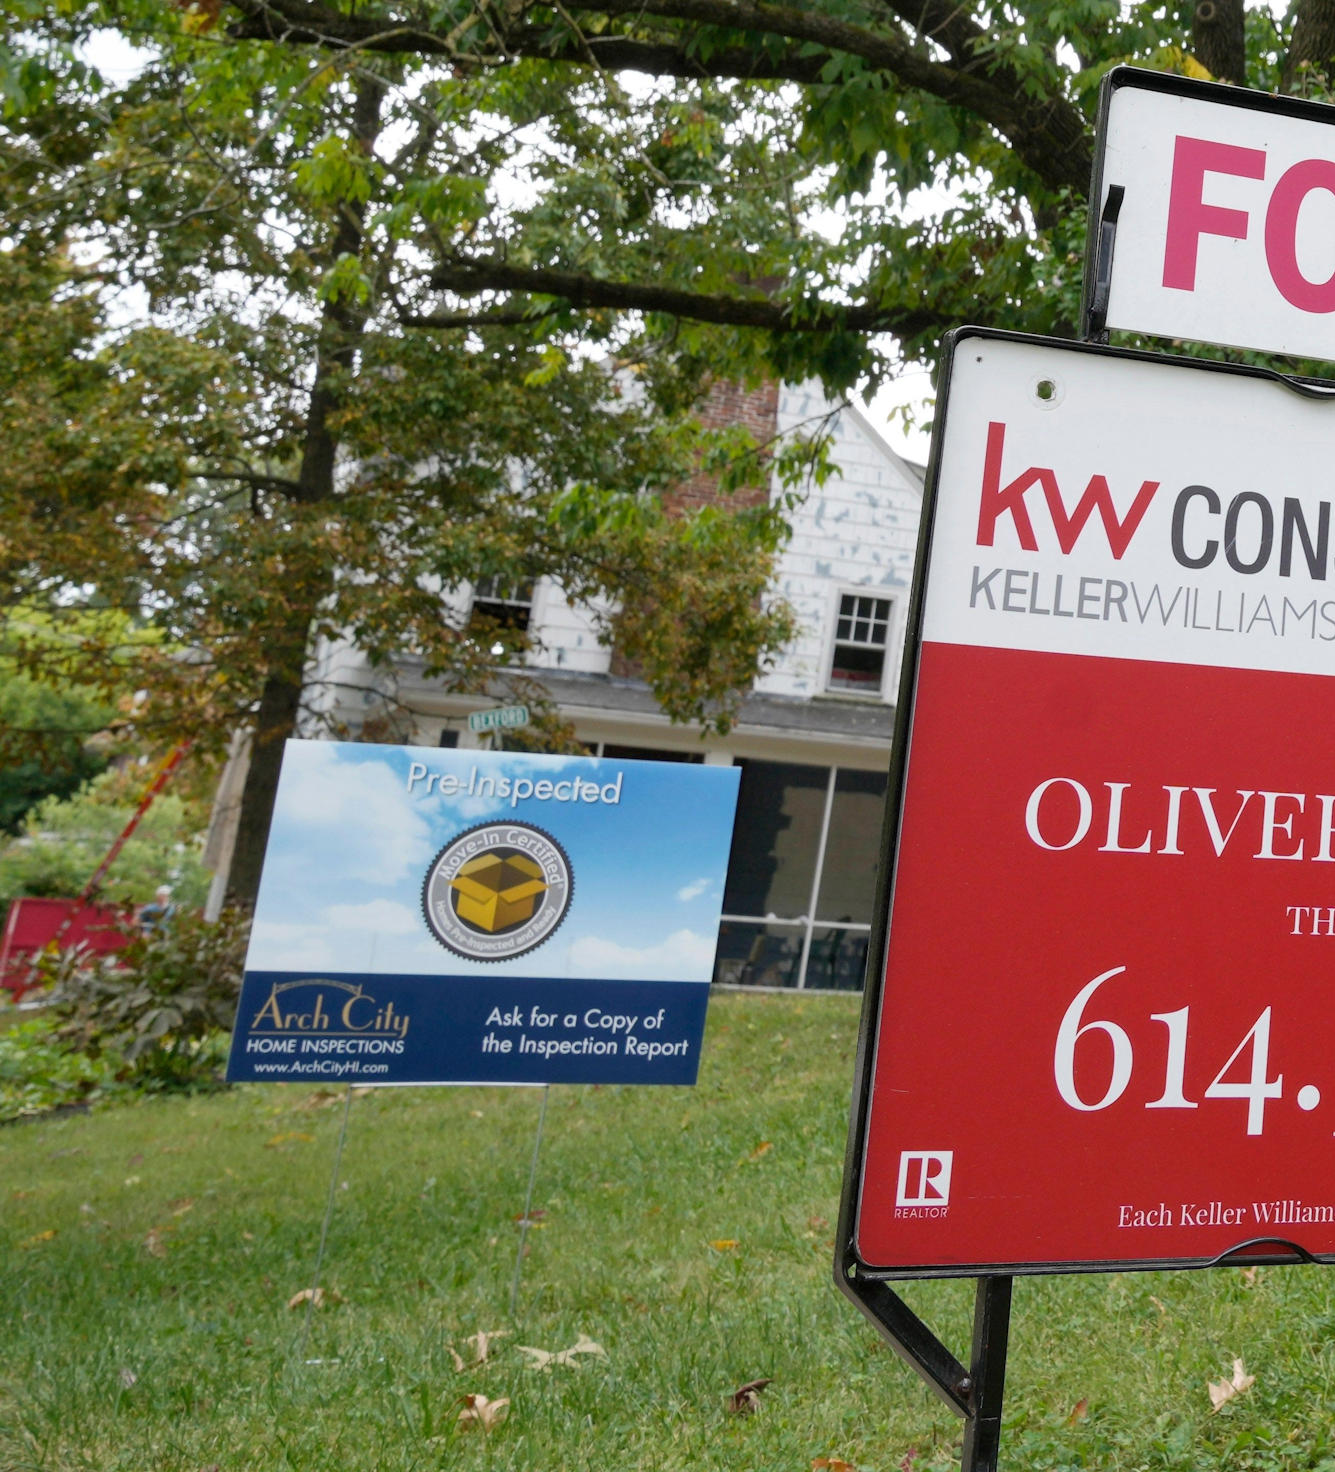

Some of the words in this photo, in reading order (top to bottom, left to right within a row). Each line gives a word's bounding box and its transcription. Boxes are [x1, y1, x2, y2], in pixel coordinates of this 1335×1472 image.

[975, 421, 1160, 561] kw
[407, 762, 624, 808] Pre-Inspected
[438, 832, 500, 881] Move-In
[506, 830, 563, 885] Certified
[517, 929, 535, 943] and
[252, 990, 329, 1029] Arch
[342, 995, 410, 1039] City
[485, 1005, 523, 1027] Ask
[530, 1005, 558, 1028] for
[563, 1014, 578, 1028] a
[584, 1008, 638, 1035] Copy
[643, 1008, 665, 1029] of
[246, 1038, 297, 1054] HOME
[301, 1039, 405, 1055] INSPECTIONS
[481, 1032, 513, 1054] the
[519, 1033, 618, 1060] Inspection
[625, 1036, 689, 1061] Report
[254, 1059, 389, 1077] www.ArchCityHI.com
[894, 1207, 948, 1220] REALTOR
[1118, 1201, 1173, 1228] Each
[1179, 1201, 1247, 1226] Keller
